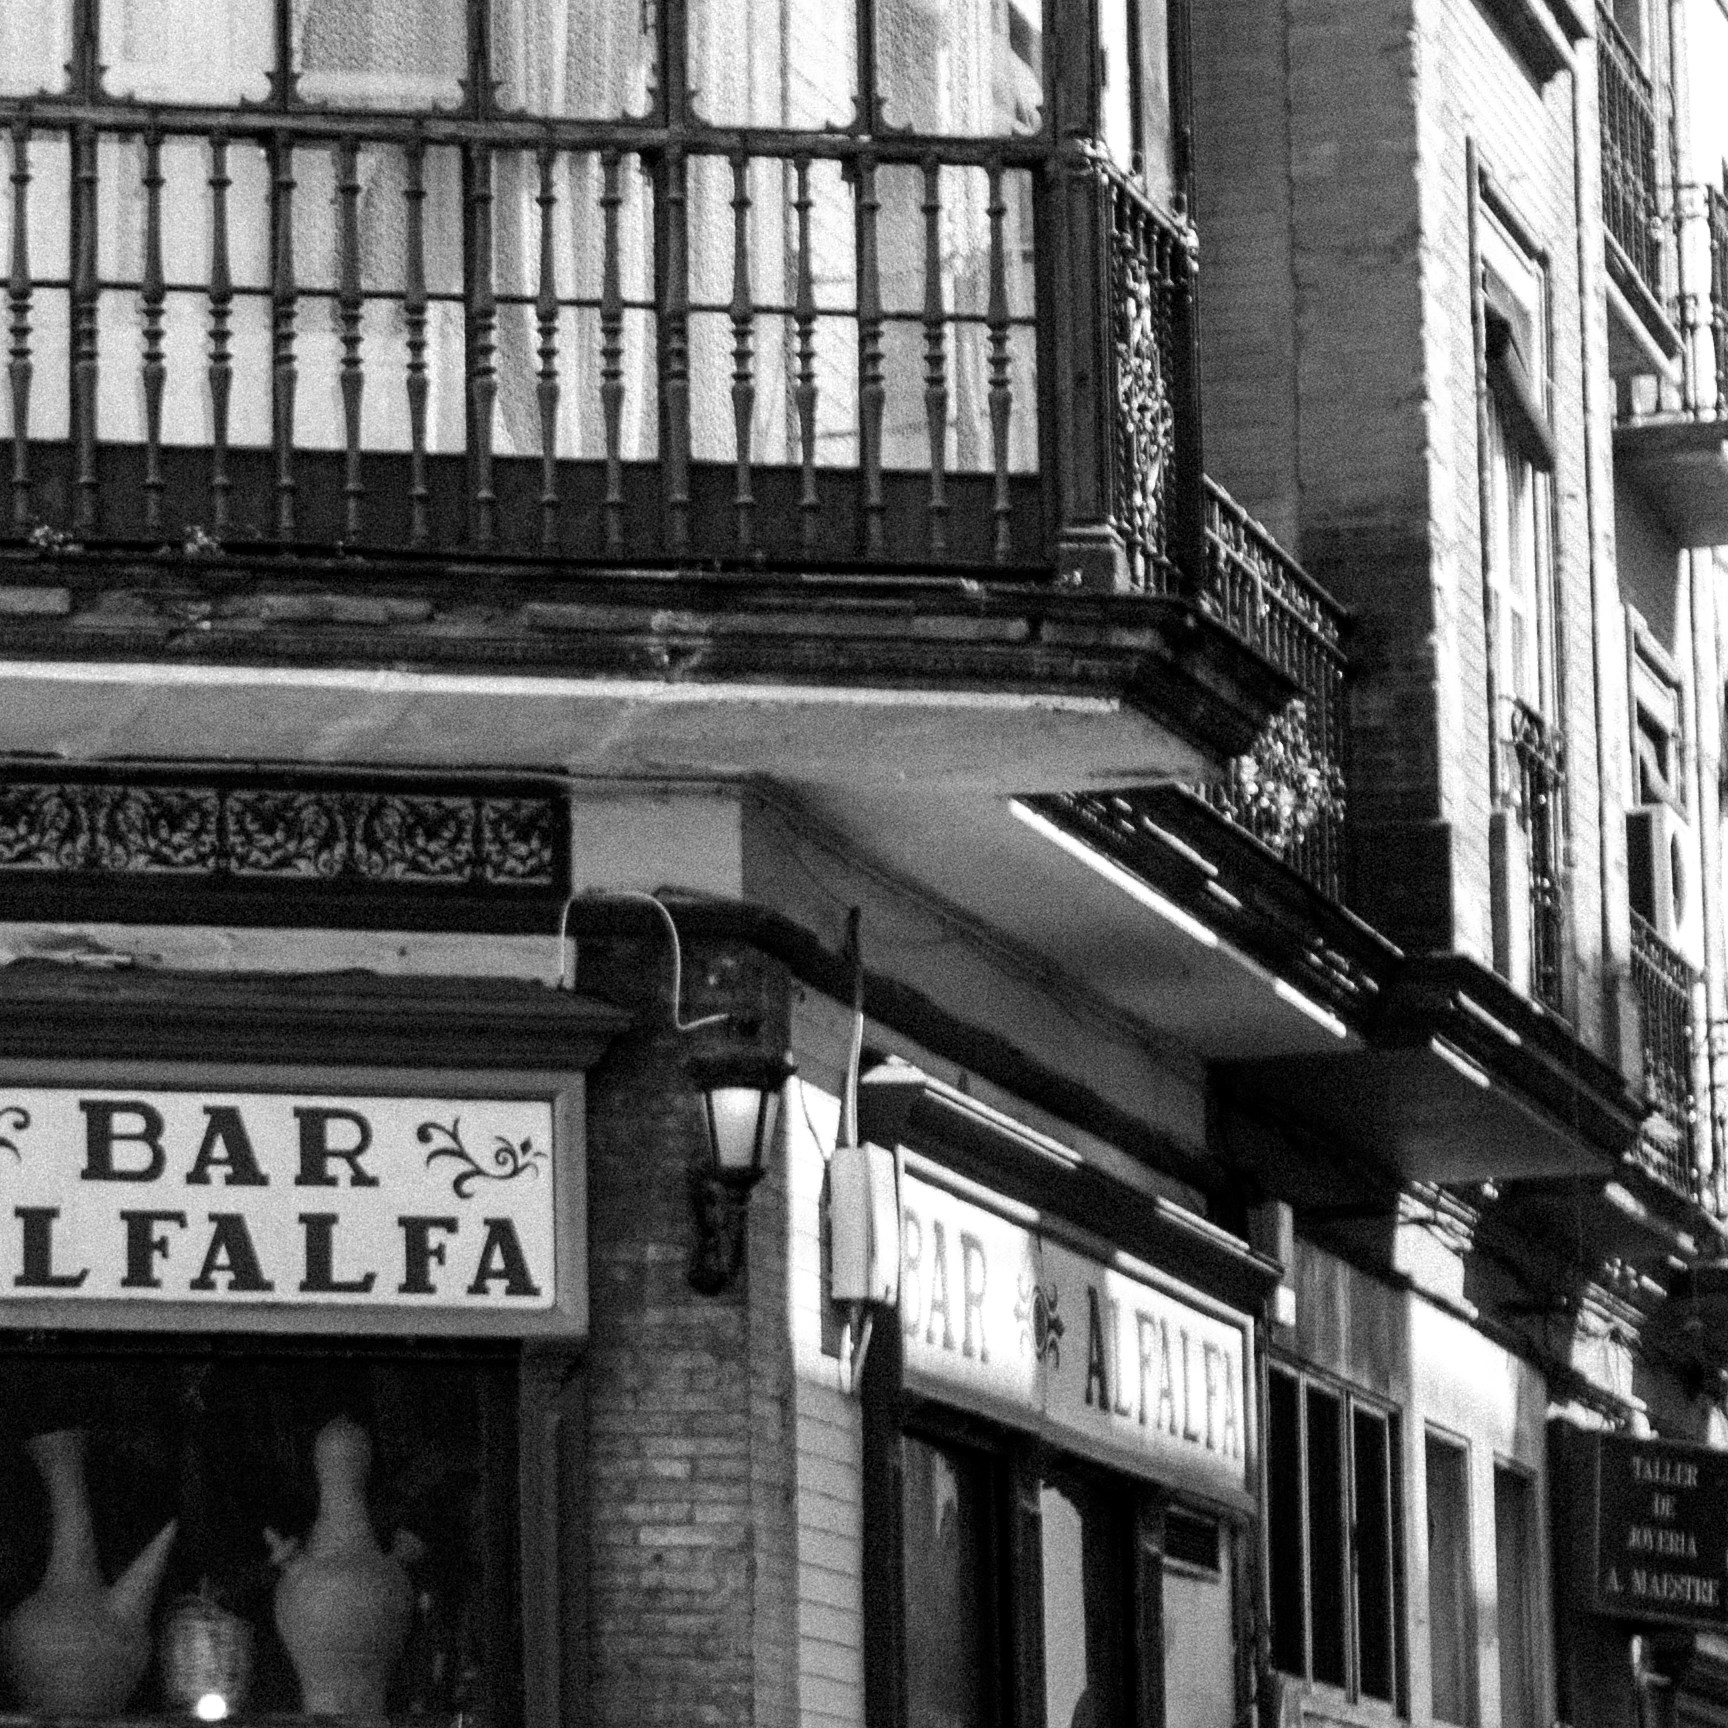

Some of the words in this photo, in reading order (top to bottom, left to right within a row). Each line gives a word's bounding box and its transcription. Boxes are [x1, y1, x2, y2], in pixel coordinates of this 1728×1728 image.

[78, 1098, 380, 1188] BAR
[901, 1206, 989, 1364] BAR
[1085, 1284, 1240, 1459] ALFALFA
[1631, 1456, 1700, 1488] TALLER
[1652, 1492, 1676, 1519] DE
[1631, 1568, 1720, 1607] MAESTRE
